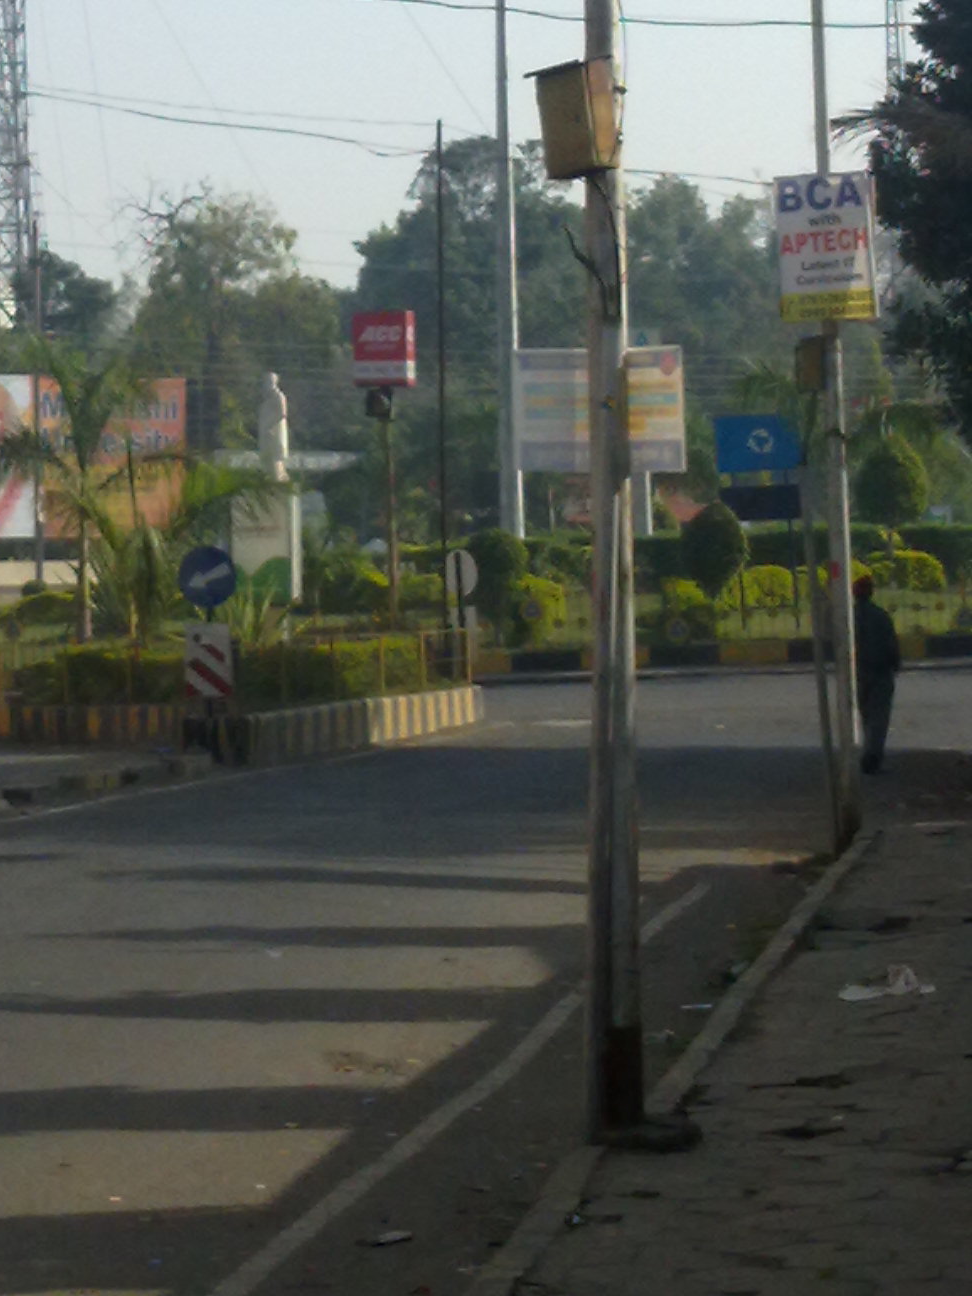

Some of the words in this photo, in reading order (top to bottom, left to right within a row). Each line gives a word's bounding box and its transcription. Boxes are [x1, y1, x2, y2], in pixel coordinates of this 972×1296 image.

[780, 175, 862, 212] BCA
[780, 227, 869, 255] APTECH
[358, 325, 403, 342] ACC
